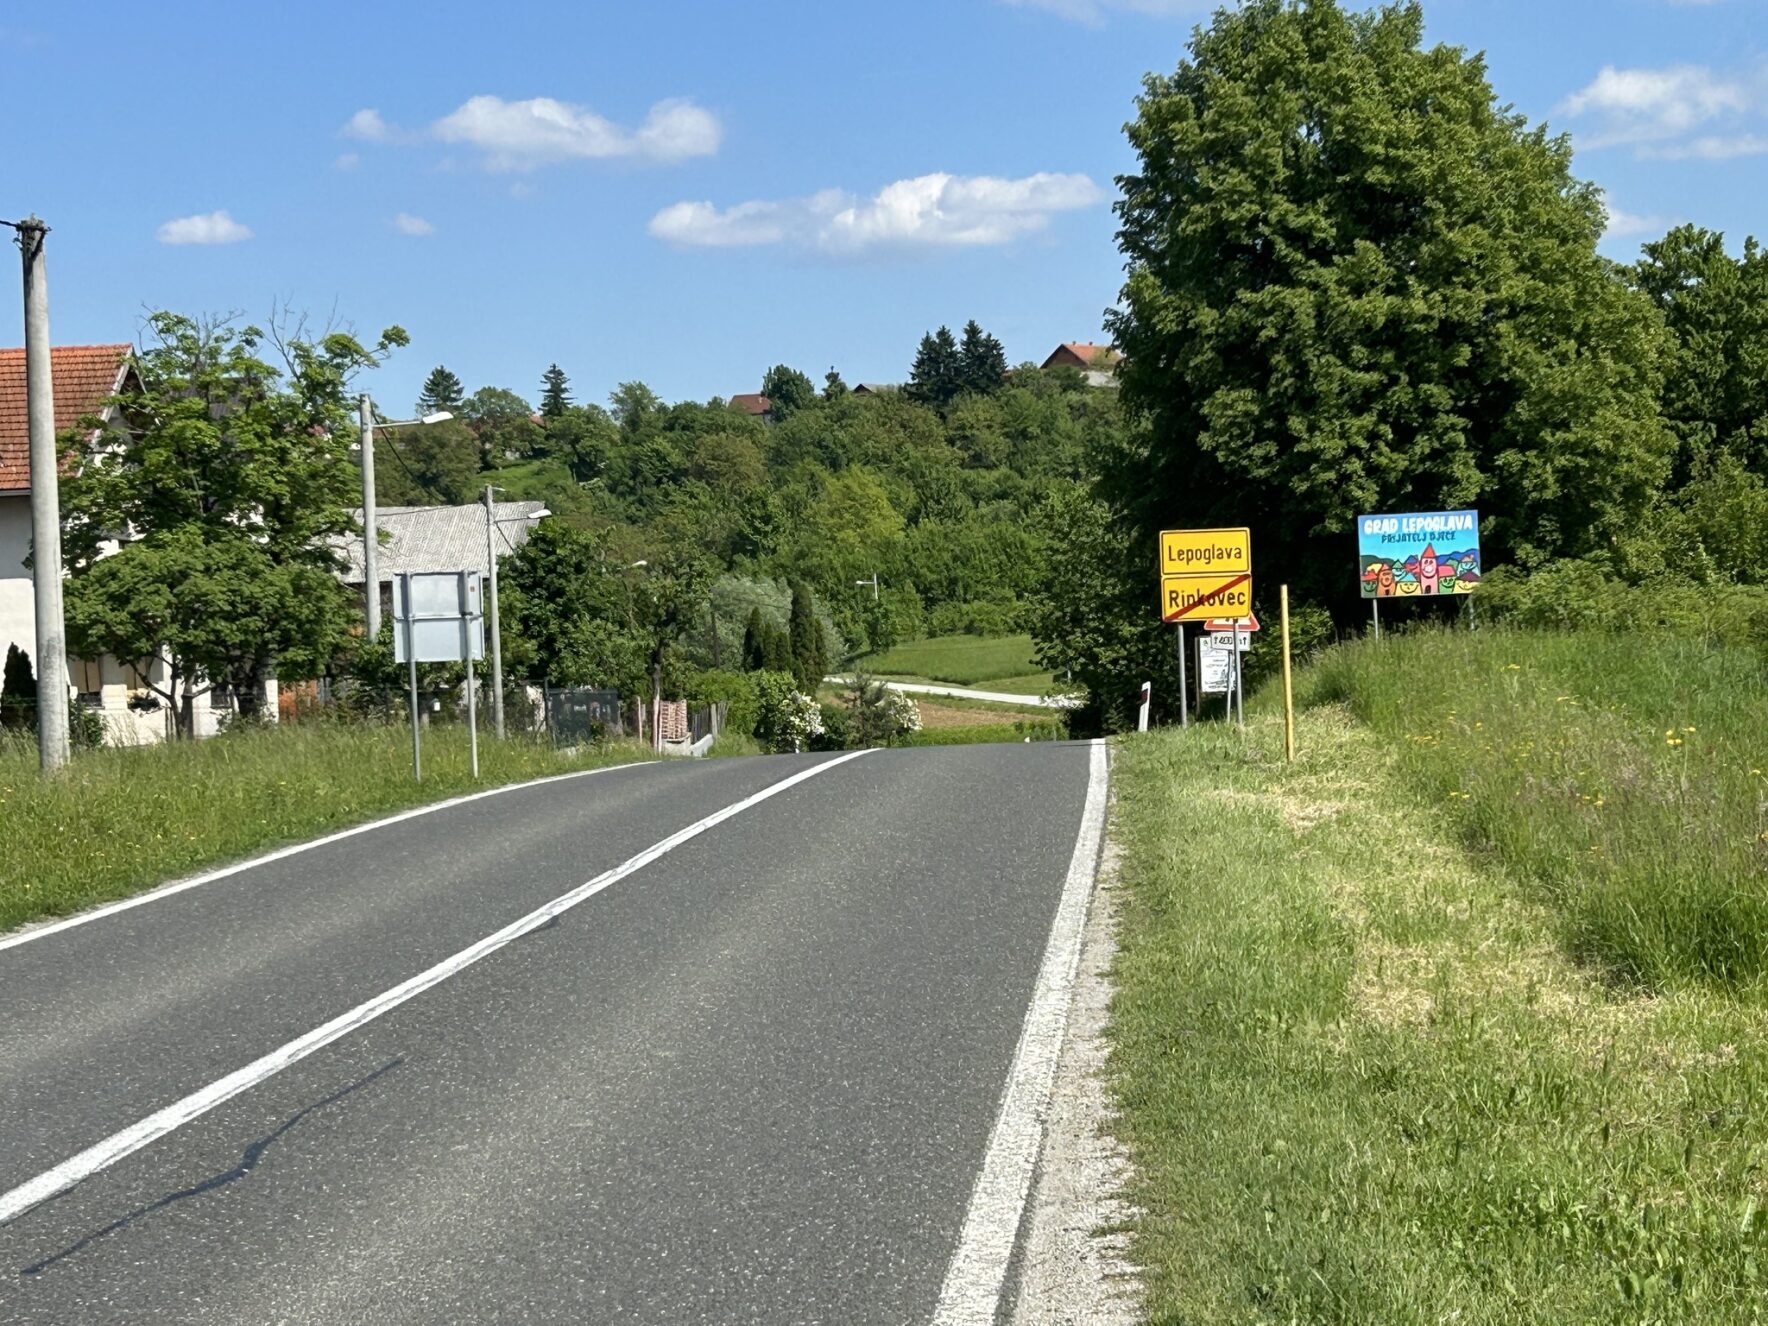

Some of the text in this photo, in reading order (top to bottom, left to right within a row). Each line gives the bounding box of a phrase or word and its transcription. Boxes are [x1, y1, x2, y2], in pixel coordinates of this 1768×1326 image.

[1364, 515, 1472, 535] GRAD LEPOGLAVA
[1168, 543, 1242, 565] Lepoglava
[1169, 588, 1246, 608] Rinkovec
